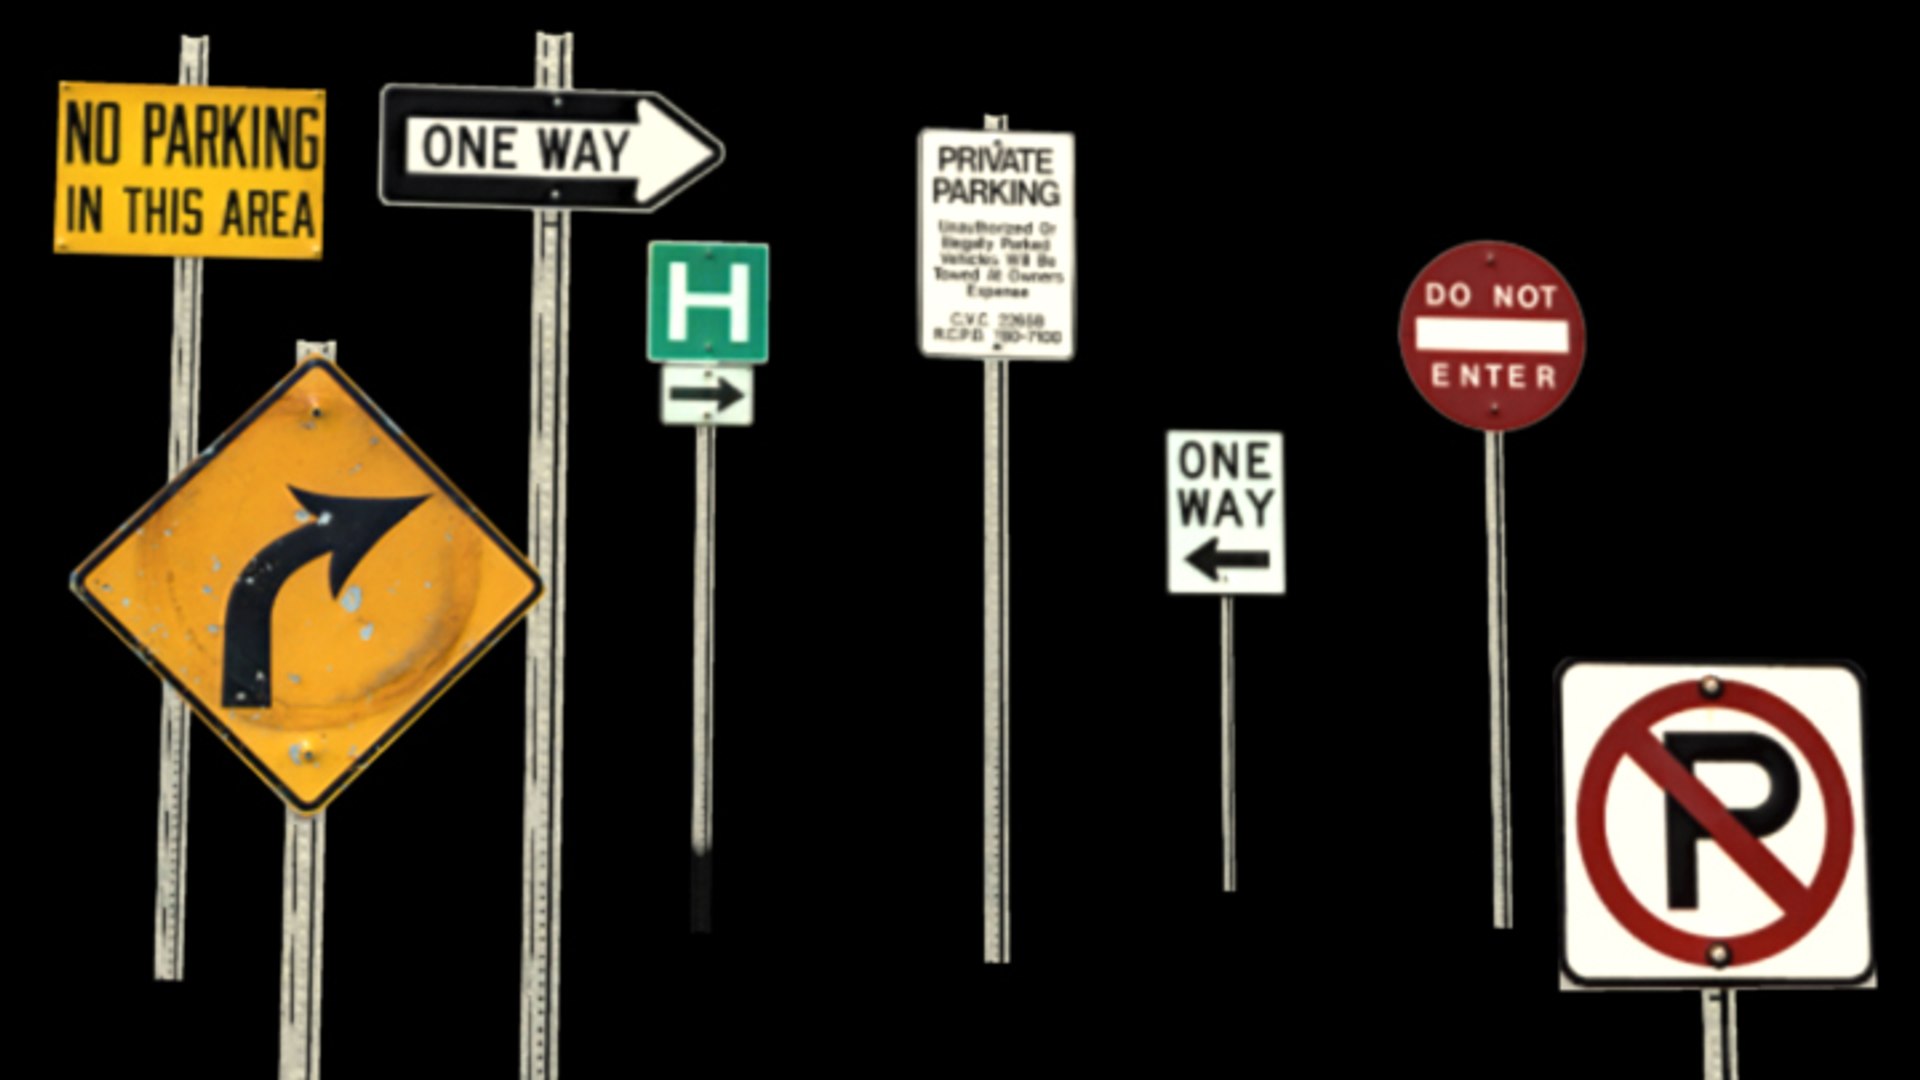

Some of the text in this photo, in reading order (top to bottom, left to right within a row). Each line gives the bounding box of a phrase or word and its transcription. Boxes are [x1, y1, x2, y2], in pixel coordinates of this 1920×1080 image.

[65, 100, 319, 170] NO PARKING
[423, 124, 630, 172] ONE WAY
[938, 146, 1053, 174] PRIVATE
[67, 186, 315, 238] IN THIS AREA
[933, 177, 1060, 207] PARKING
[667, 261, 750, 343] H
[1425, 282, 1557, 309] DO NOT
[1431, 362, 1556, 389] ENTER
[1179, 440, 1271, 480] ONE
[1177, 488, 1275, 528] WAY
